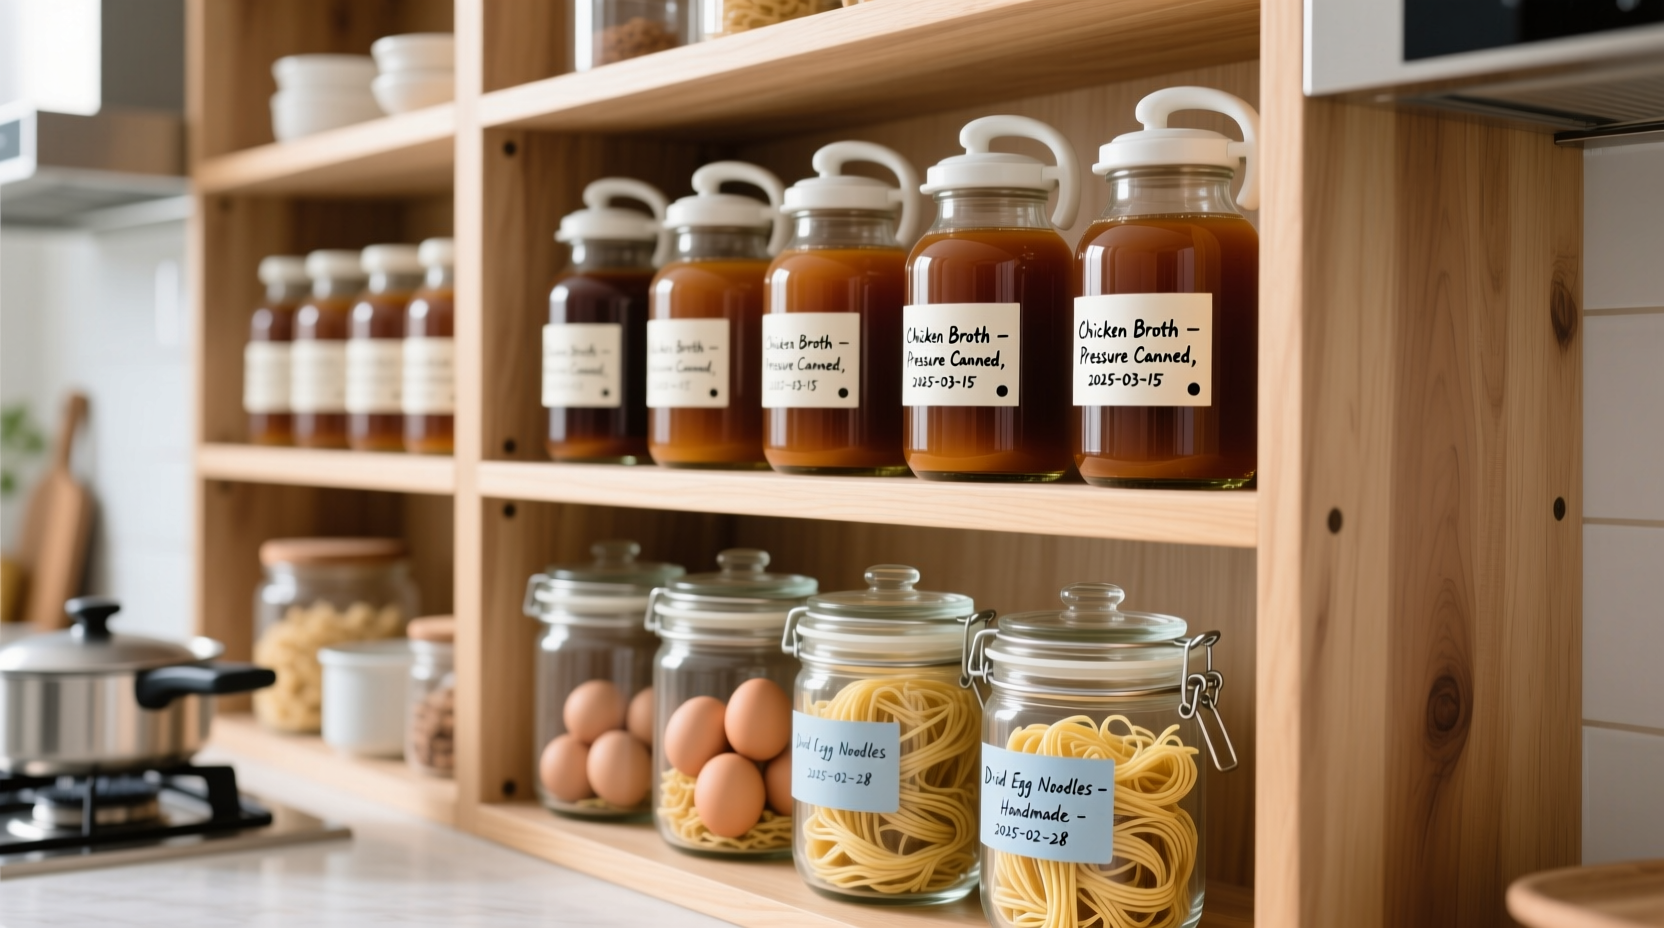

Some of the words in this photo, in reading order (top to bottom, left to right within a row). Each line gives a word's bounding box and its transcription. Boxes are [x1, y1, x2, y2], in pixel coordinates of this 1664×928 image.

[948, 325, 990, 345] Broth
[1078, 318, 1127, 339] Chicken
[1133, 318, 1179, 339] Broth
[798, 333, 833, 350] Broth
[950, 350, 1005, 371] Canned,
[1079, 345, 1129, 365] Pressure
[1133, 345, 1197, 368] Canned,
[1088, 372, 1164, 387] 2025-03-15
[839, 741, 886, 759] Noodles
[1011, 771, 1033, 799] Egg
[1037, 776, 1093, 796] Noodles
[1000, 797, 1070, 823] Handmade
[994, 822, 1069, 847] 2025-02-28
